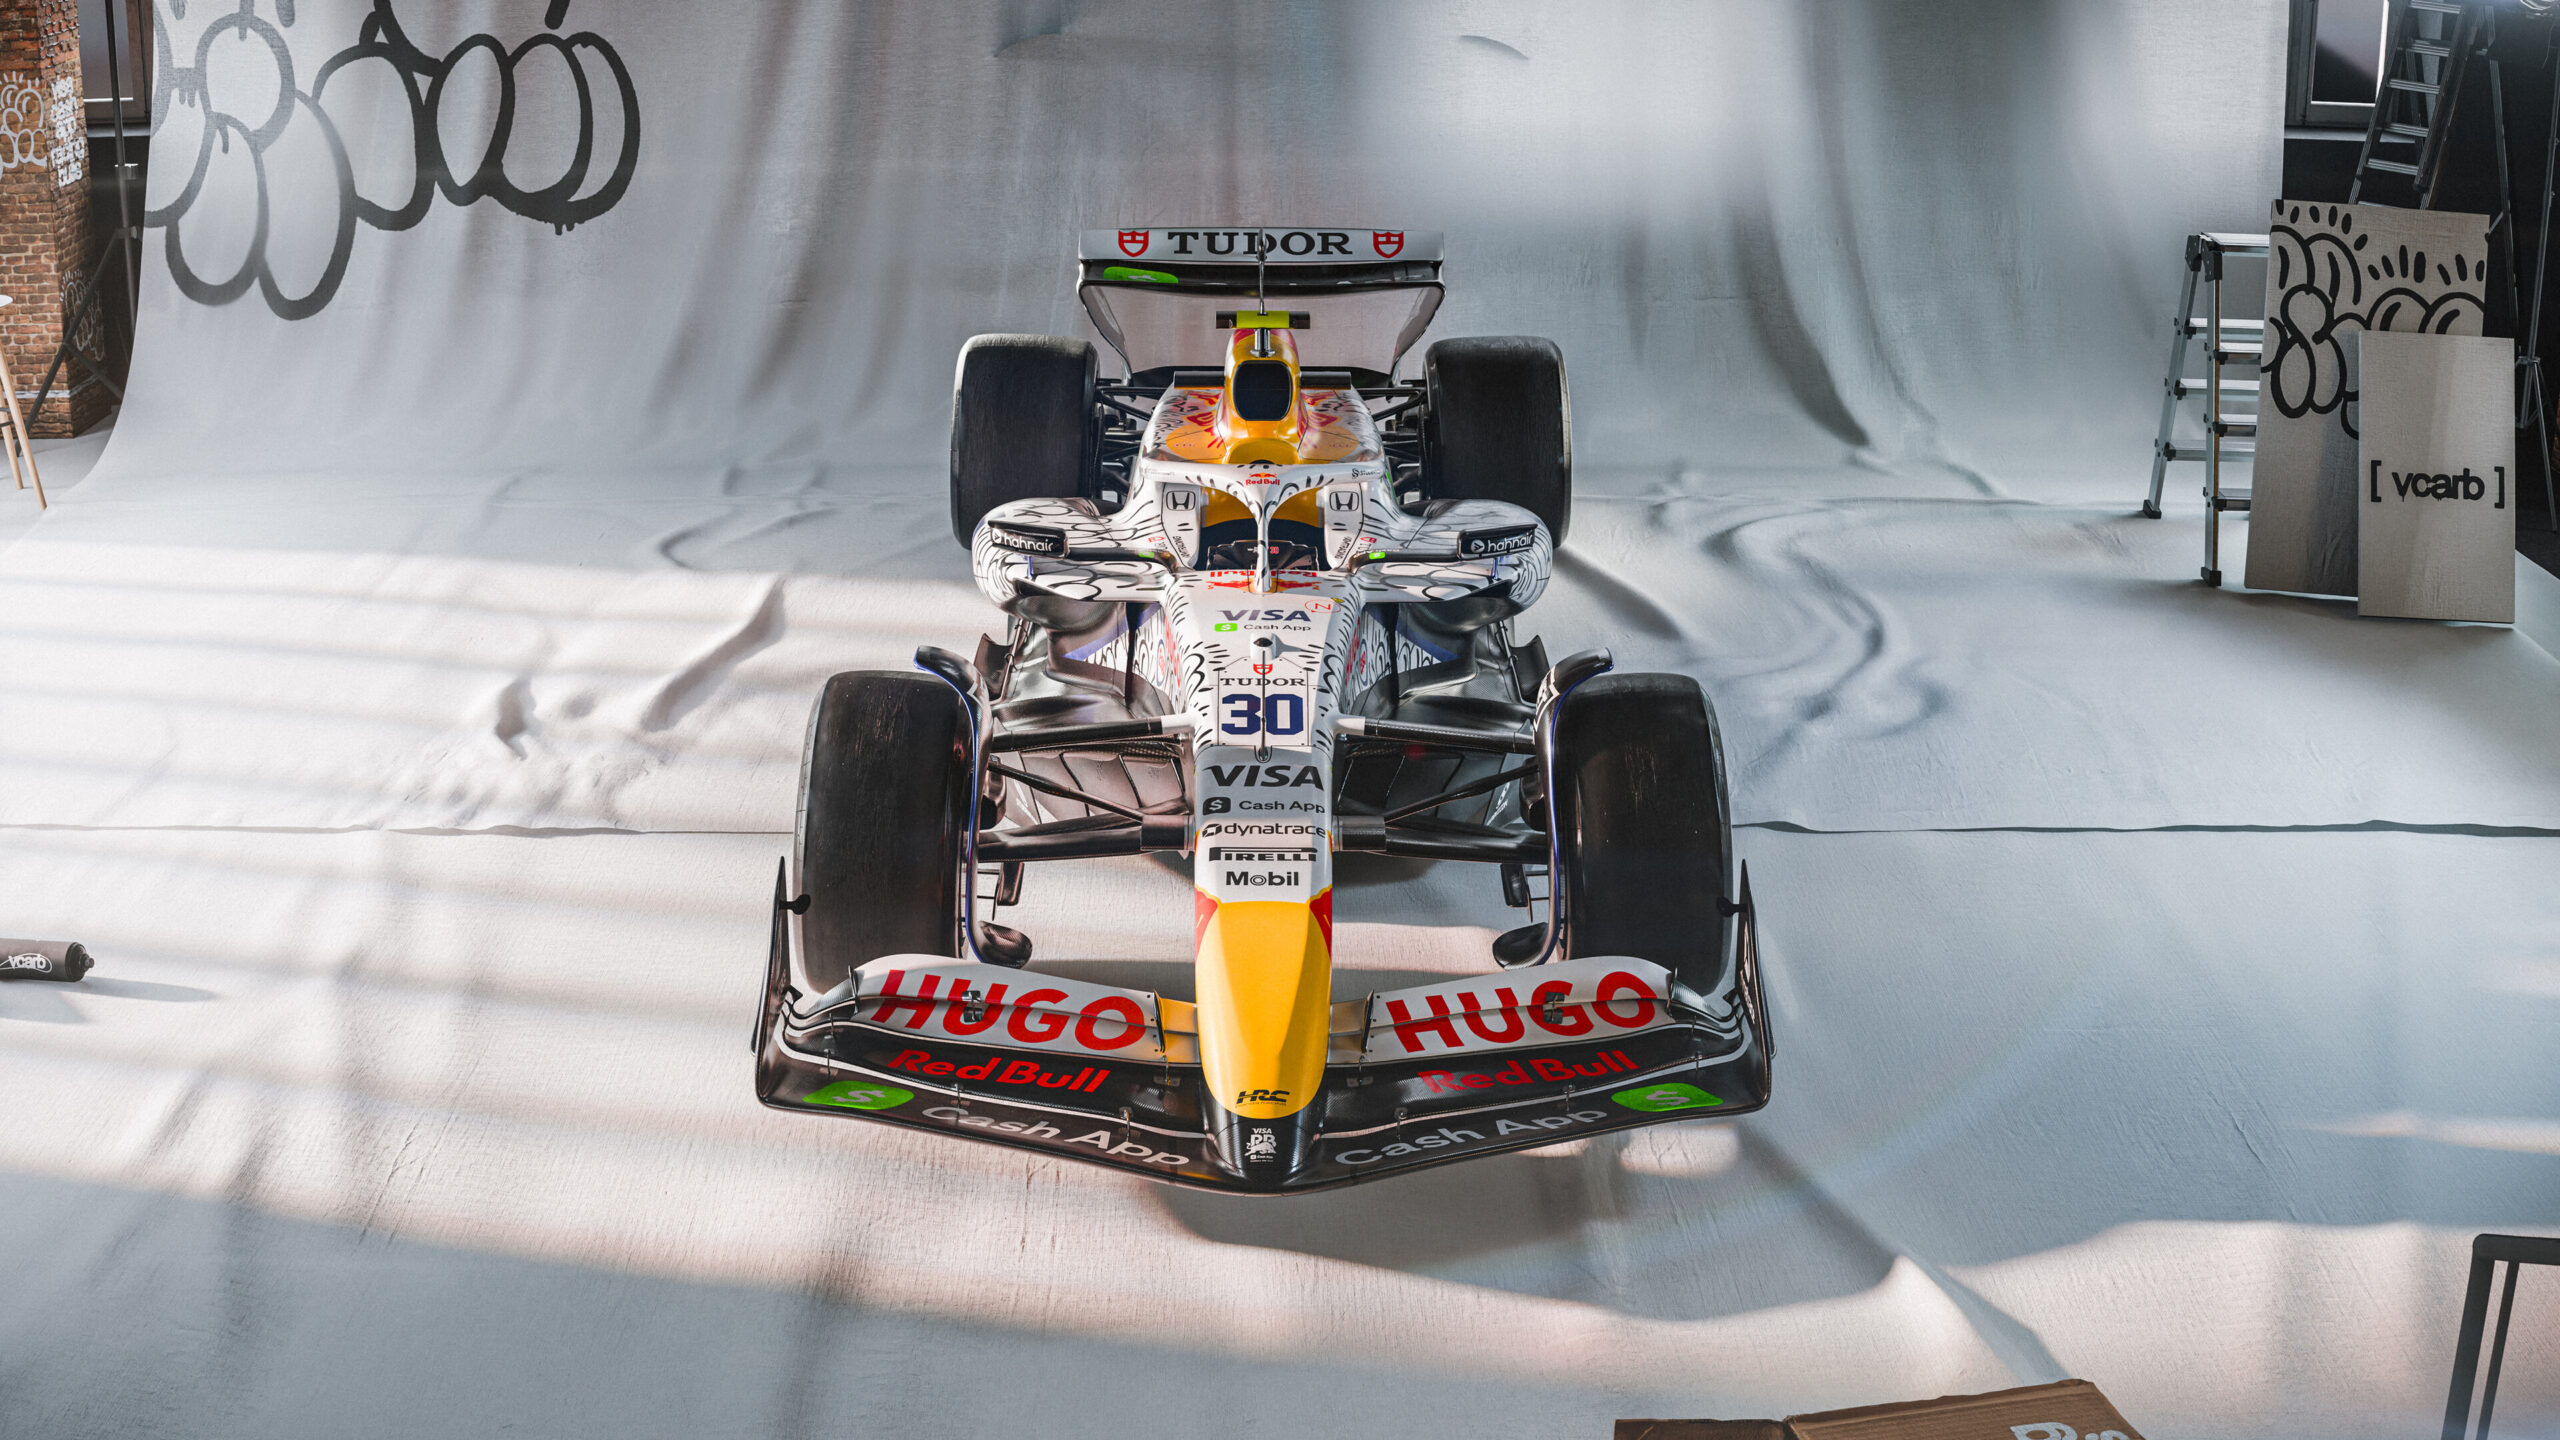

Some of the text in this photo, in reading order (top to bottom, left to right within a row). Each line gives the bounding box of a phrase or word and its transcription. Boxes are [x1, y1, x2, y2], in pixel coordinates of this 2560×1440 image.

[1167, 231, 1353, 255] TUDOR
[2392, 468, 2485, 501] vcarb
[1003, 533, 1053, 552] hahnair
[1487, 533, 1534, 553] hahnair
[1217, 609, 1312, 622] VISA
[1244, 623, 1278, 631] Cash
[1281, 623, 1312, 632] App
[1220, 677, 1306, 687] TUDOR
[1221, 693, 1304, 736] 30
[1202, 765, 1325, 791] VISA
[1239, 800, 1285, 811] Cash
[1289, 800, 1326, 814] App
[1224, 822, 1326, 839] dynatrace
[1209, 847, 1318, 862] PIRELLI
[1226, 871, 1299, 887] Mobil
[8, 954, 46, 969] vcarb
[870, 969, 1146, 1051] HUGO
[1384, 971, 1658, 1053] HUGO
[887, 1049, 1111, 1093] Red Bull
[1416, 1050, 1640, 1093] Red Bull
[1236, 1089, 1290, 1104] HRC
[921, 1105, 1064, 1141] Cash
[1063, 1129, 1190, 1168] App
[1334, 1126, 1489, 1166] Cash
[1494, 1109, 1609, 1137] App
